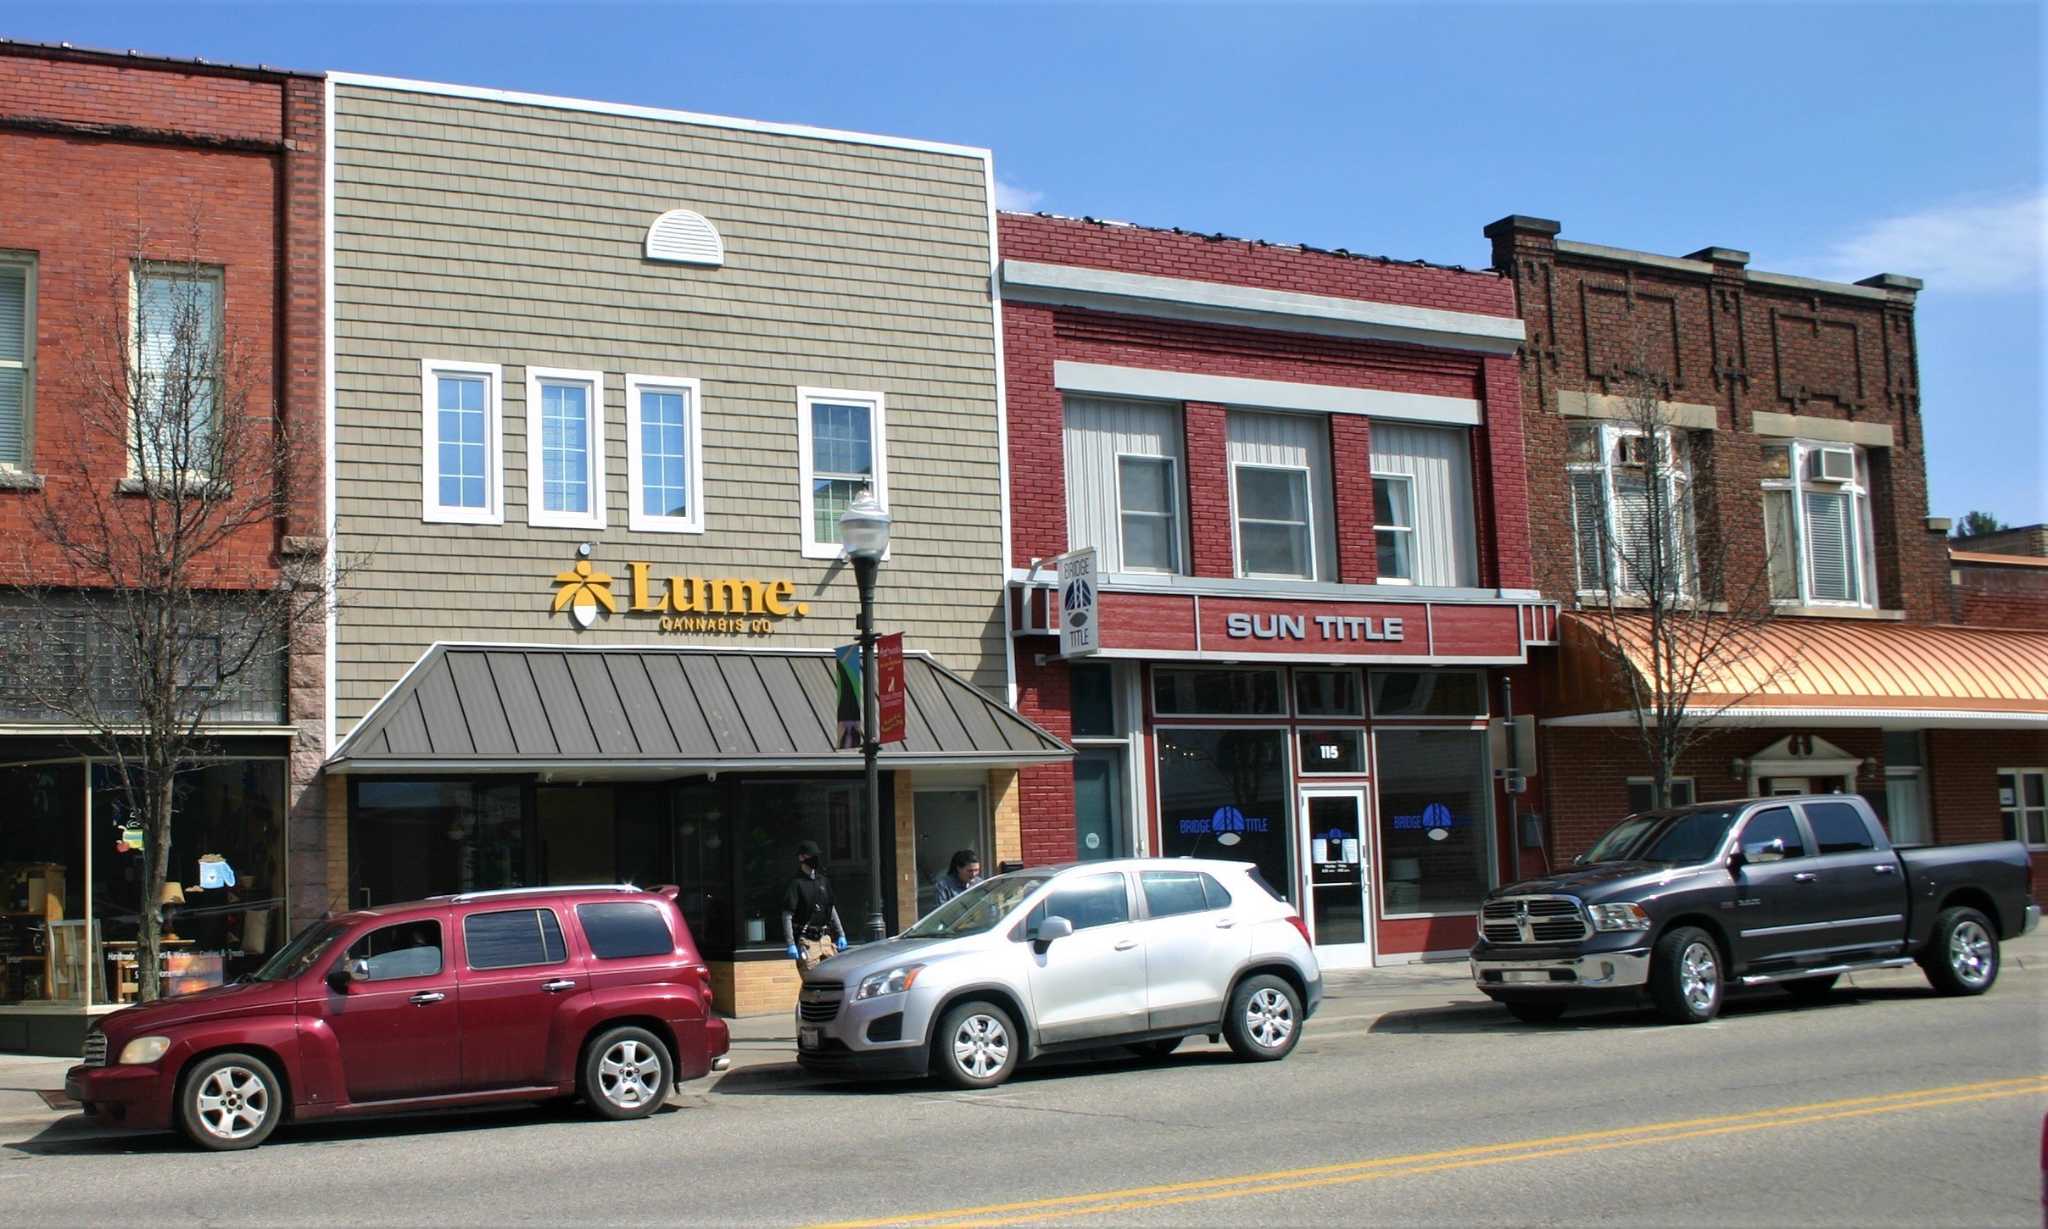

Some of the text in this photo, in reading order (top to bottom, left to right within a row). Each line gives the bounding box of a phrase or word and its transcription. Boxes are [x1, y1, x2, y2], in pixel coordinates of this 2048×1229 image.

[1064, 557, 1089, 579] BRIDGE
[628, 560, 810, 616] Lume.
[661, 616, 744, 632] CANNABIS
[1227, 613, 1405, 641] SUN TITLE
[1069, 627, 1089, 648] TITLE
[1319, 745, 1339, 759] 115
[1180, 818, 1269, 833] BRIDGE TITLE
